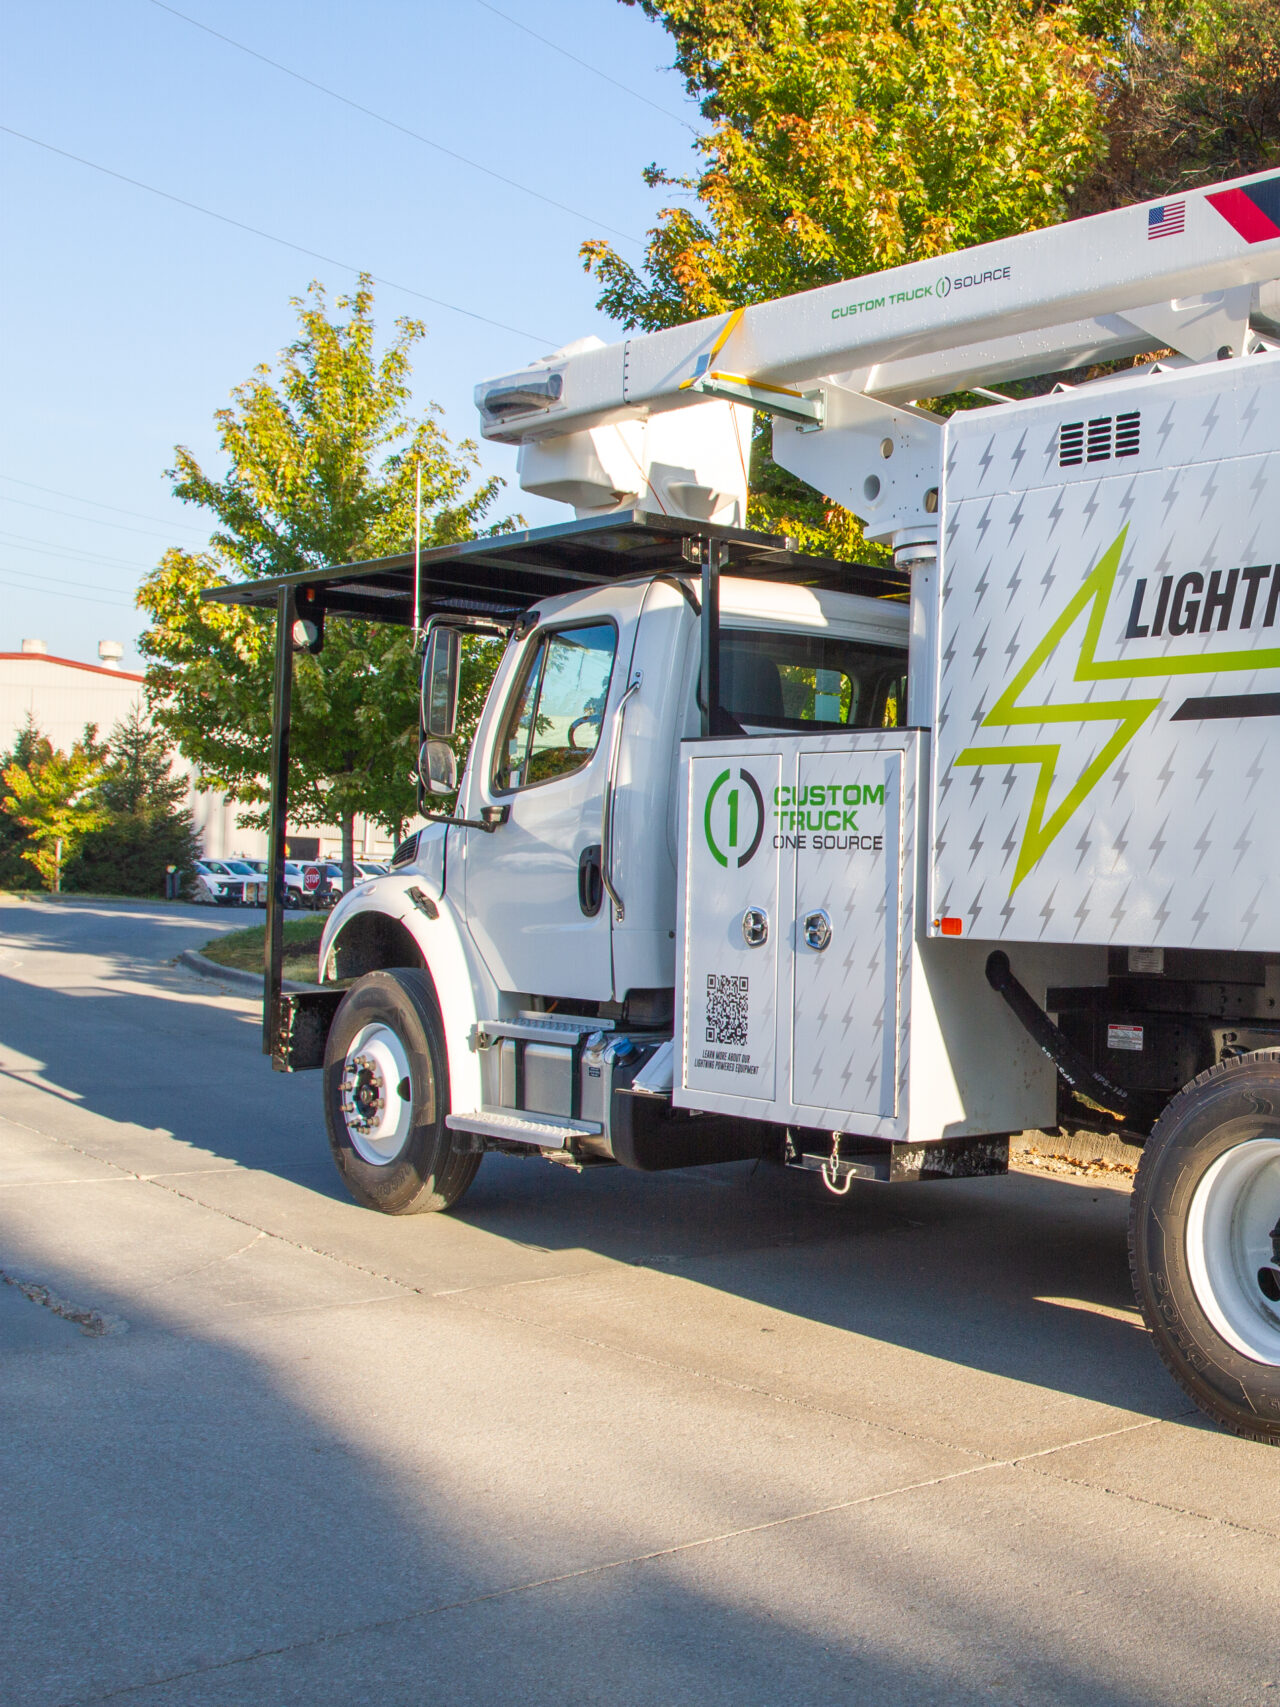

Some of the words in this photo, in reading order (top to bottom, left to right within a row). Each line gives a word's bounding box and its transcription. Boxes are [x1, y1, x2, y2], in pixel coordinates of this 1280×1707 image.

[831, 297, 885, 319] CUSTOM
[888, 285, 933, 305] TRUCK
[954, 266, 1011, 290] SOURCE
[773, 785, 885, 806] CUSTOM
[773, 810, 859, 832] TRUCK
[772, 835, 807, 849] ONE
[812, 835, 883, 850] SOURCE
[304, 874, 320, 884] STOP
[702, 1050, 715, 1059] LEARN
[716, 1051, 728, 1061] MORE
[728, 1053, 742, 1063] ABOUT
[742, 1054, 751, 1063] OUR
[694, 1058, 715, 1069] LIGHTNING
[715, 1061, 735, 1071] POWERED
[735, 1064, 760, 1074] EQUIPMENT
